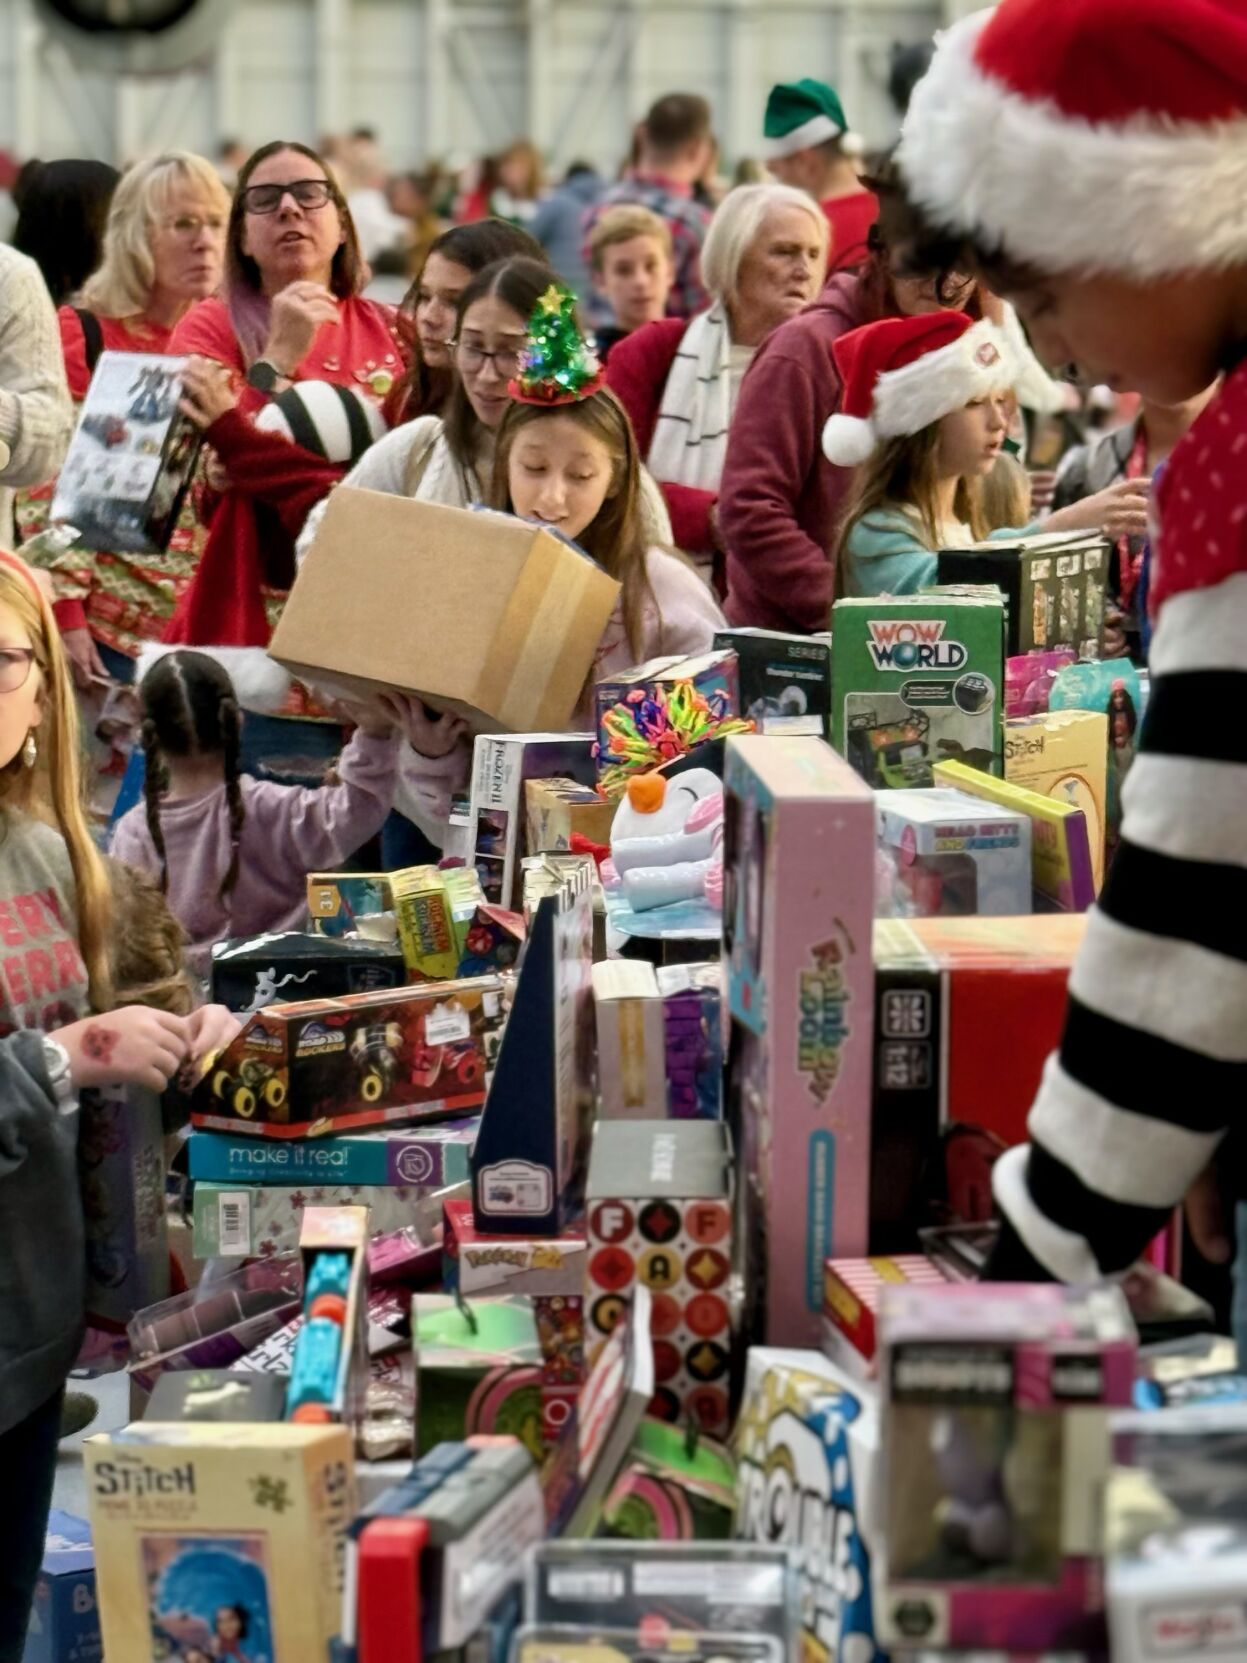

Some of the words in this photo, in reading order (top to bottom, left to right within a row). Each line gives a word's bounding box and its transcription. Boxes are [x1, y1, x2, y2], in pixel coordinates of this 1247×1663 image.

[871, 622, 942, 644] WOW
[871, 643, 965, 669] WORLD
[800, 970, 821, 1071] Loom
[808, 938, 849, 1103] Rainbow
[229, 1144, 289, 1164] make
[295, 1143, 305, 1165] it
